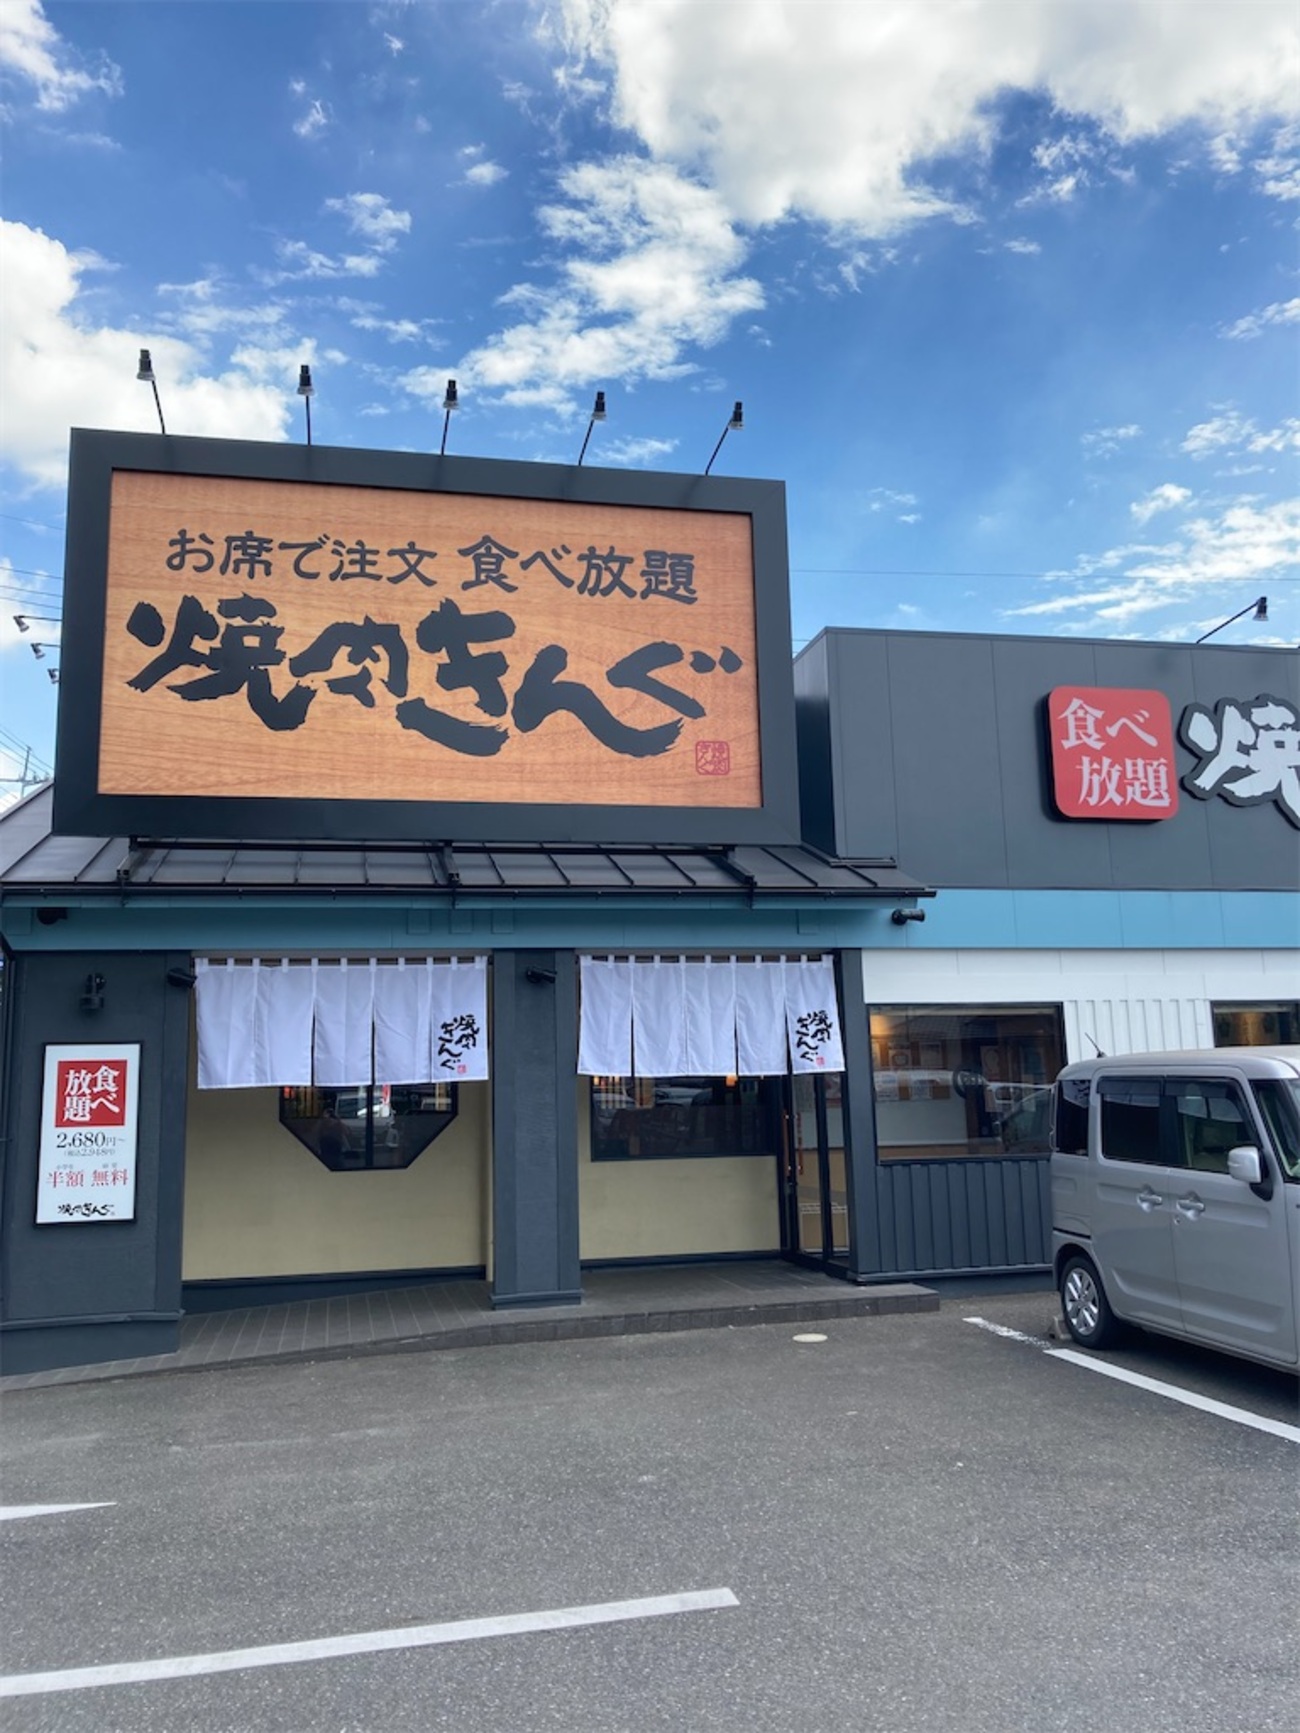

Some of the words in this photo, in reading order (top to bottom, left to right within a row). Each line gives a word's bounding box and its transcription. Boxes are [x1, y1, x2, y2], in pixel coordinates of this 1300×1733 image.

[166, 528, 438, 586] お席で注文
[458, 535, 698, 604] 食べ放題
[126, 593, 743, 758] 焼肉きんぐ
[1058, 697, 1158, 750] 食べ
[1076, 756, 1171, 806] 放題
[91, 1169, 128, 1187] 無料
